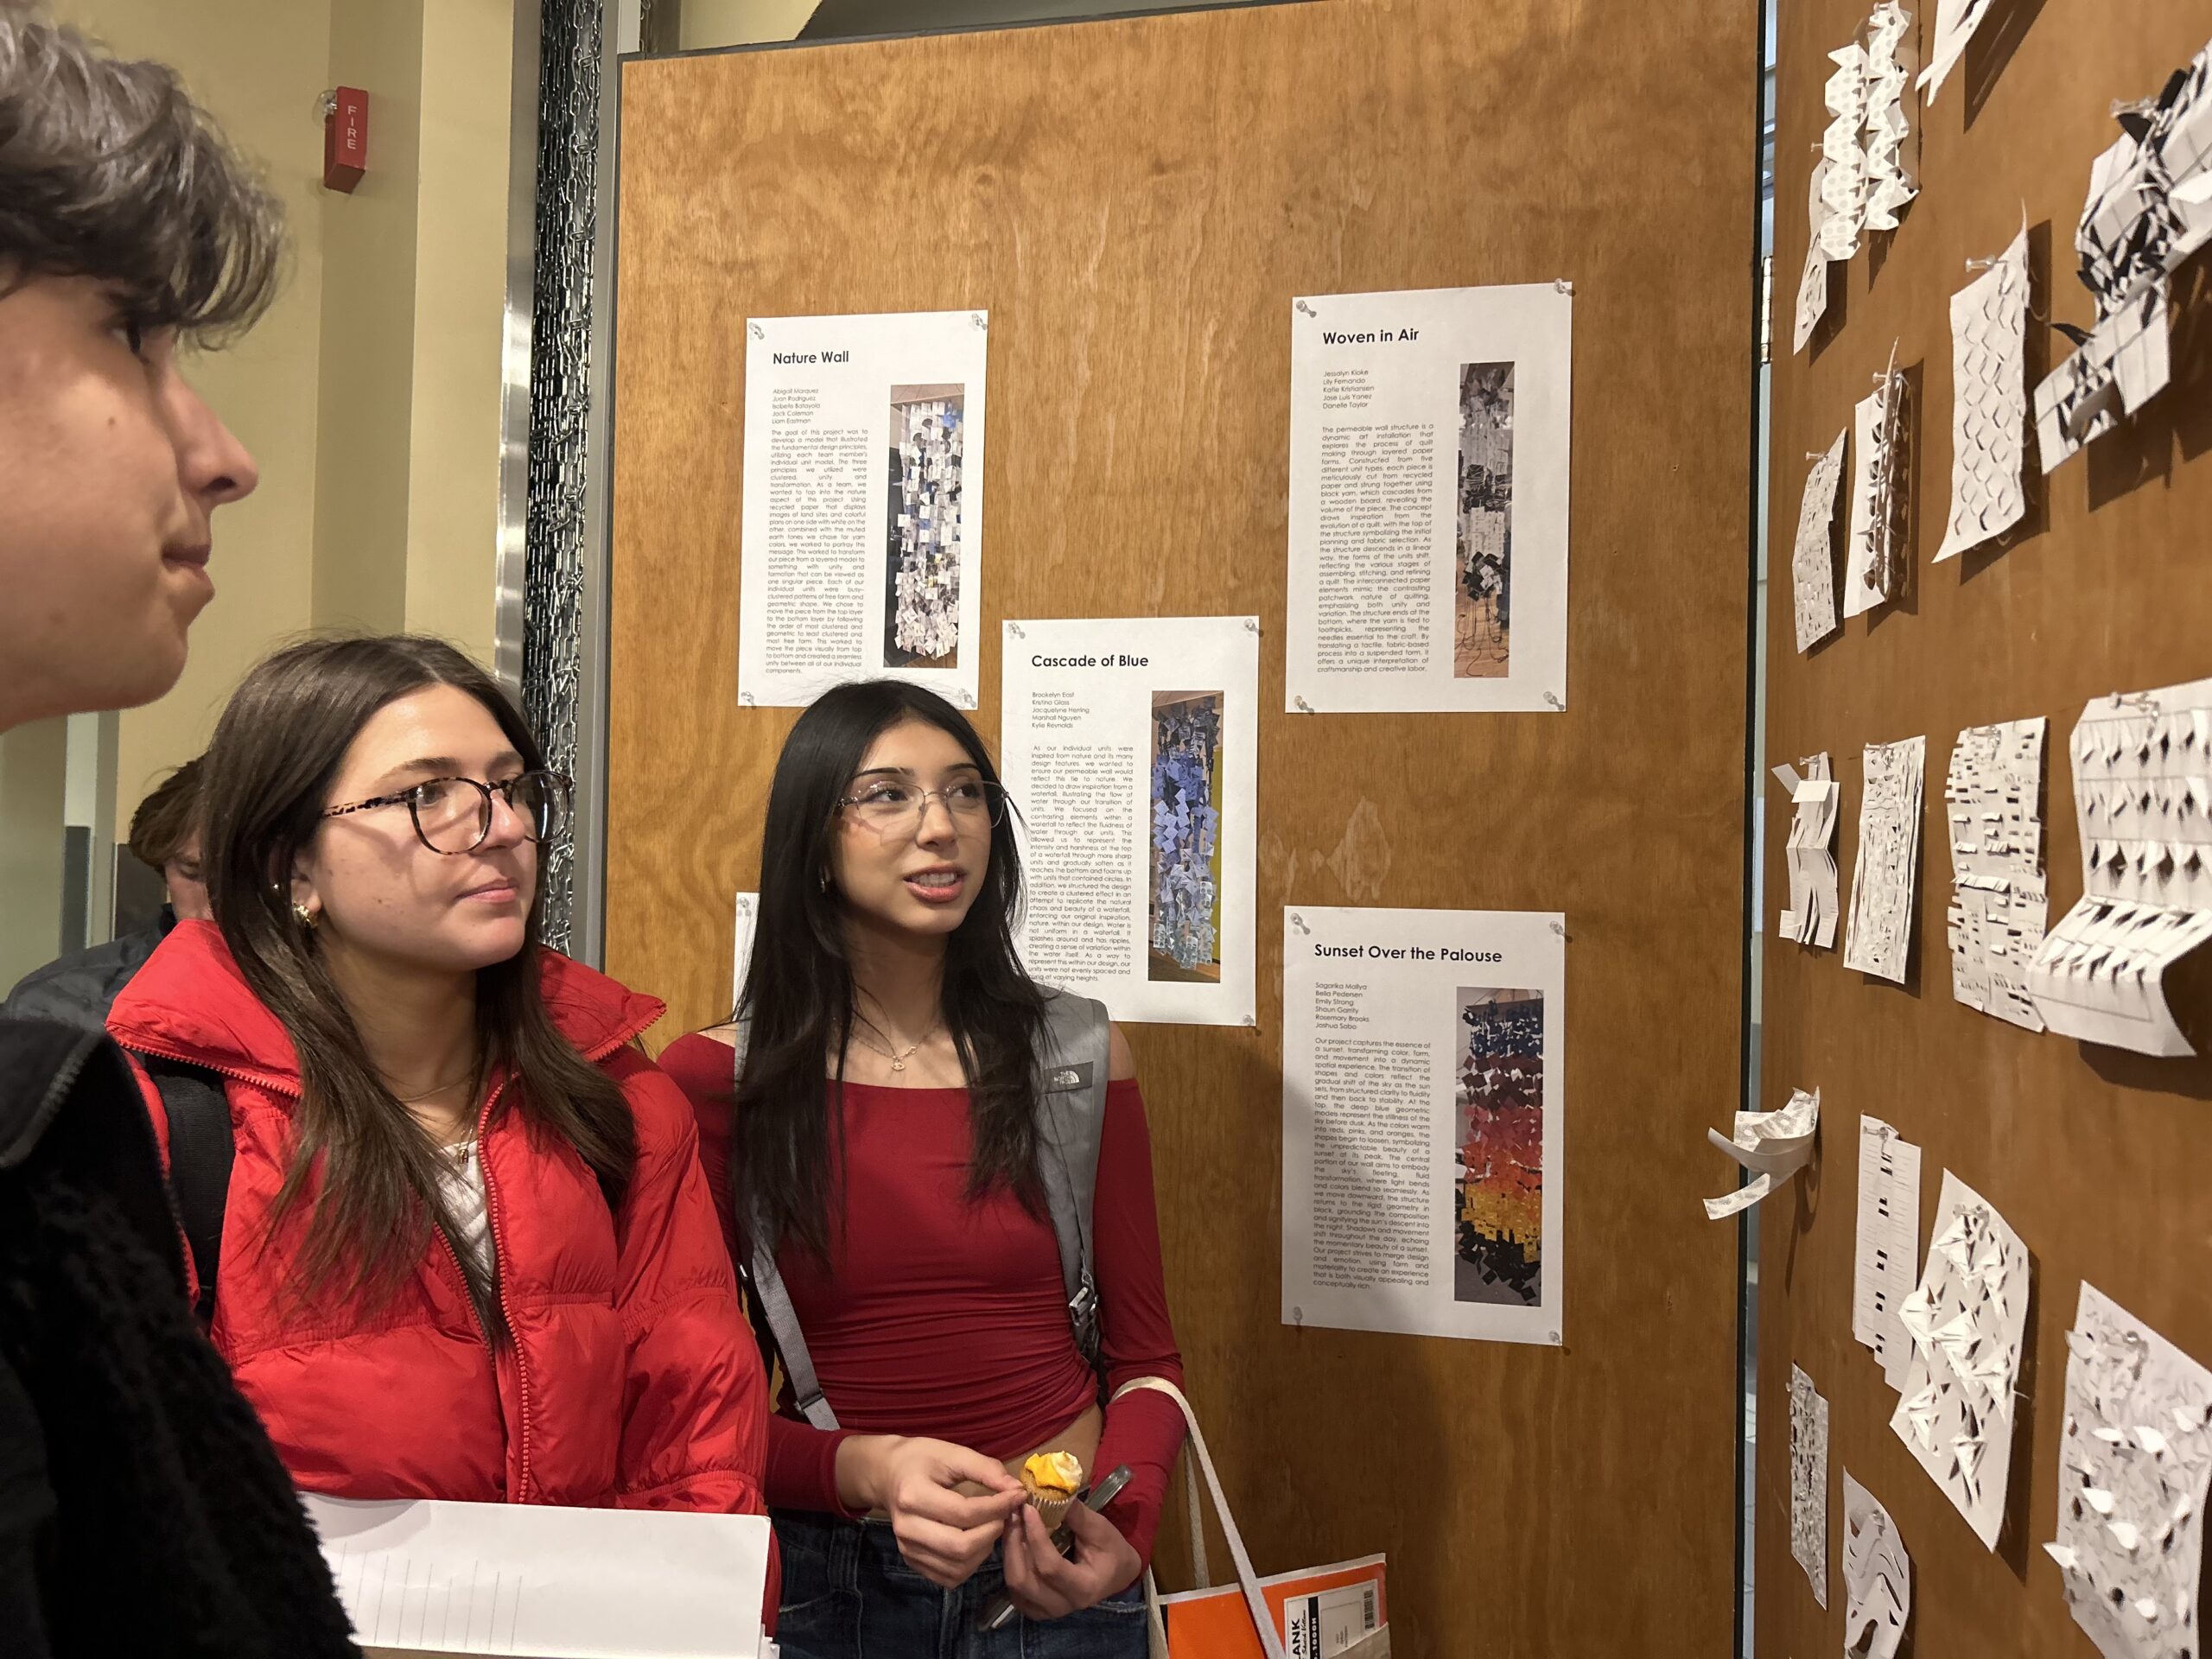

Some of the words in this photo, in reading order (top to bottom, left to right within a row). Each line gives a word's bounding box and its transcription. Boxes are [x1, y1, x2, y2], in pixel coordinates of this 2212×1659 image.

[347, 105, 358, 149] FIRE
[1322, 332, 1375, 345] Woven
[1380, 329, 1393, 342] in
[1397, 327, 1419, 341] Air
[772, 352, 817, 365] Nature
[821, 350, 849, 363] Wall
[1031, 654, 1096, 667] Cascade
[1101, 654, 1115, 667] of
[1119, 654, 1148, 666] Blue
[1314, 944, 1363, 957] Sunset
[1368, 945, 1406, 959] Over
[1410, 946, 1435, 960] the
[1440, 948, 1502, 963] Palouse
[1315, 982, 1344, 990] Sagarika
[1315, 1014, 1347, 1022] Rosemary
[1292, 1618, 1300, 1659] ANK
